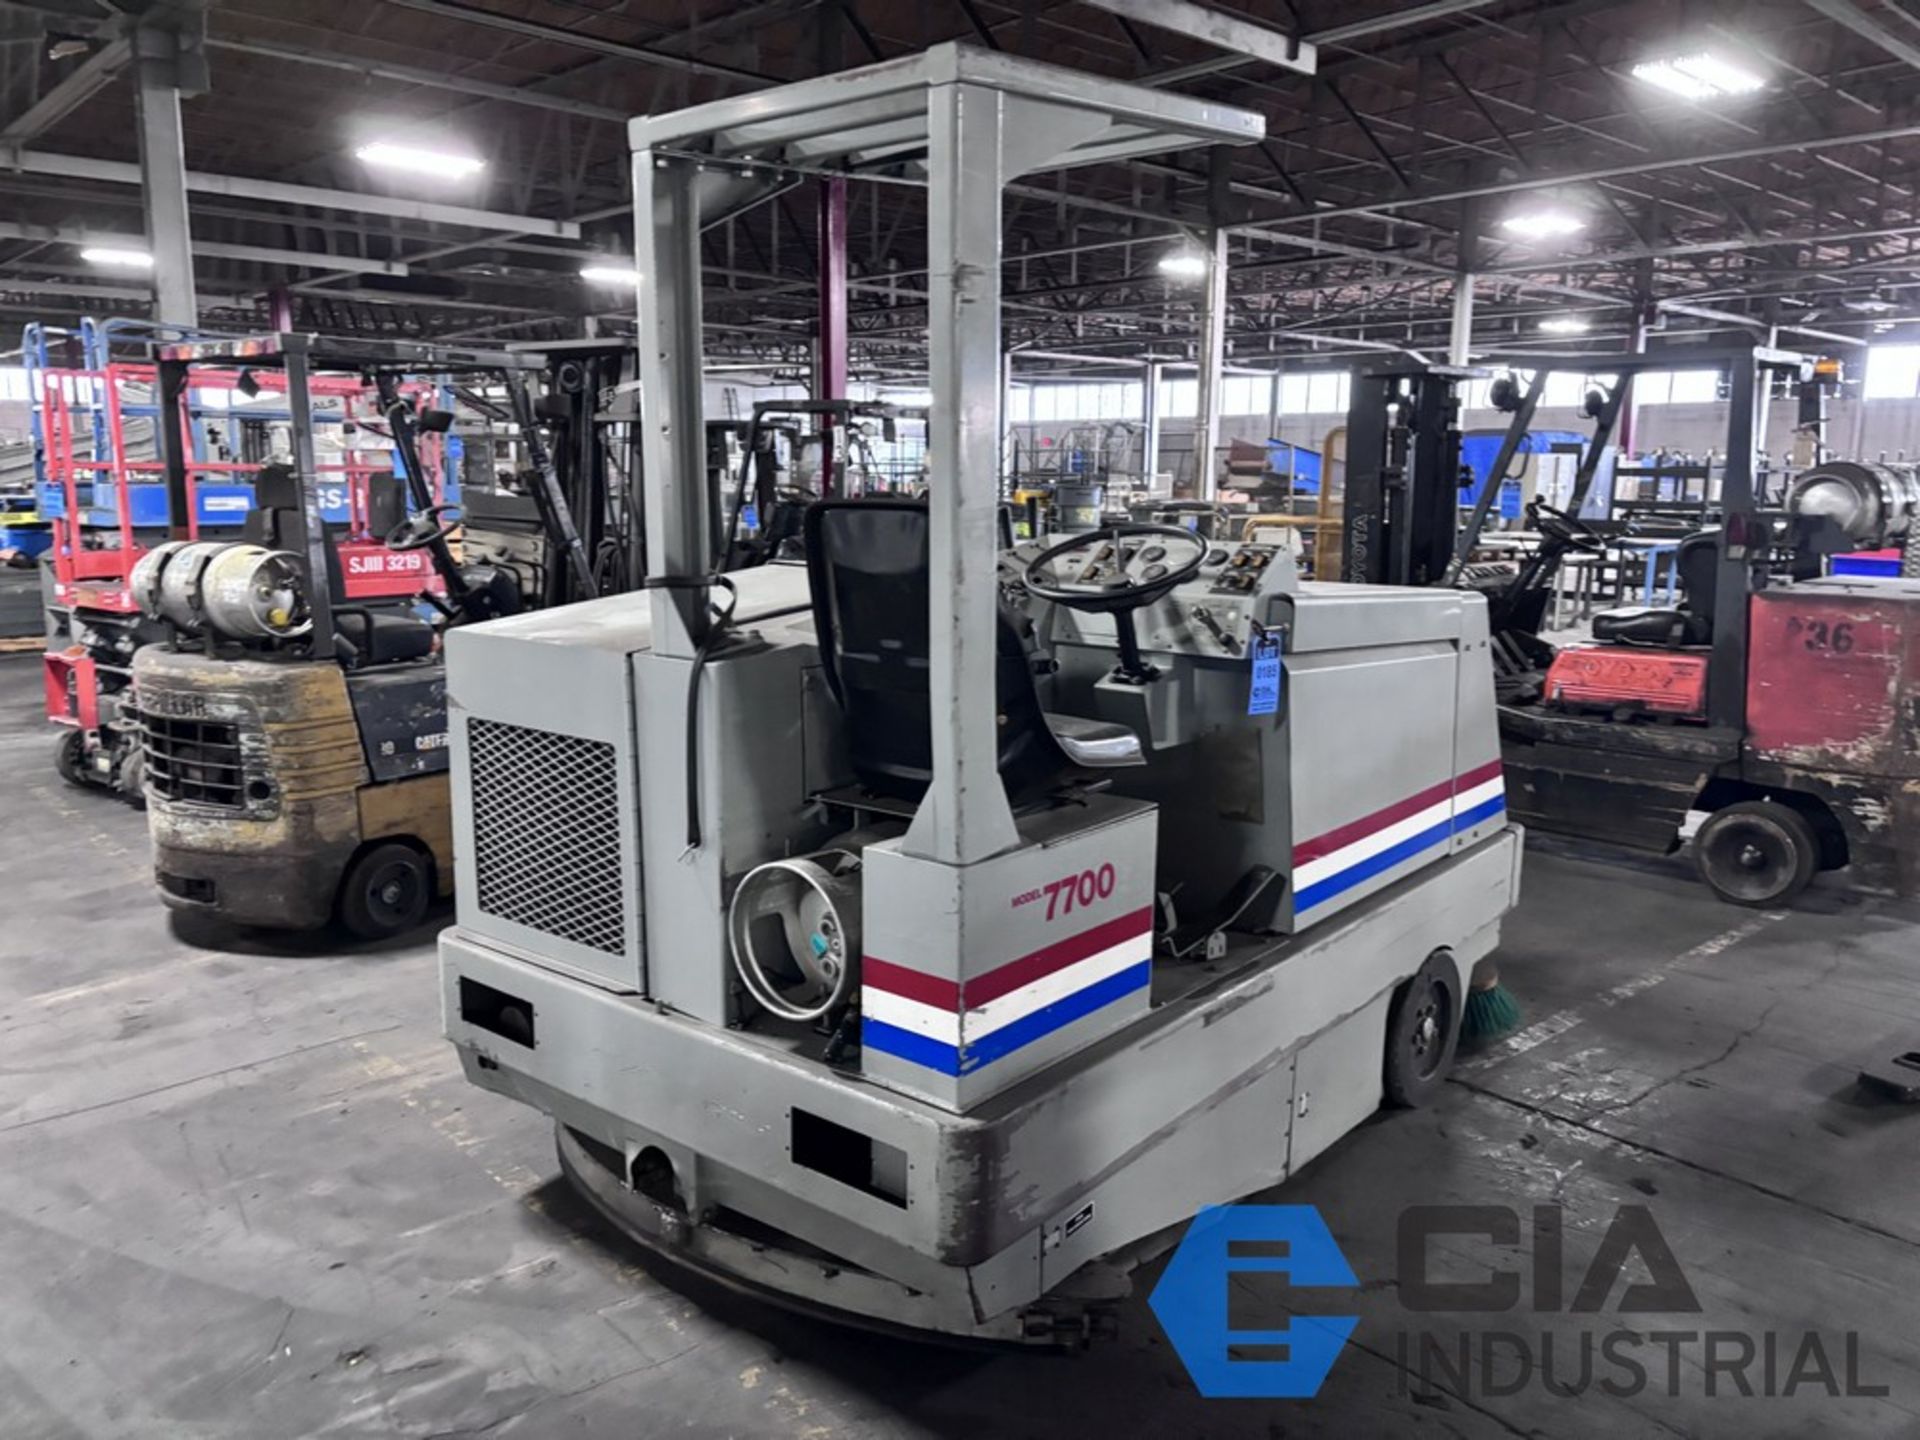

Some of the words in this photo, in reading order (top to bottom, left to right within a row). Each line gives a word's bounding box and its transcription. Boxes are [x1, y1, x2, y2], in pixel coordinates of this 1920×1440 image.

[386, 554, 421, 571] 3219
[1011, 889, 1042, 909] MODEL
[1043, 863, 1115, 922] 7700
